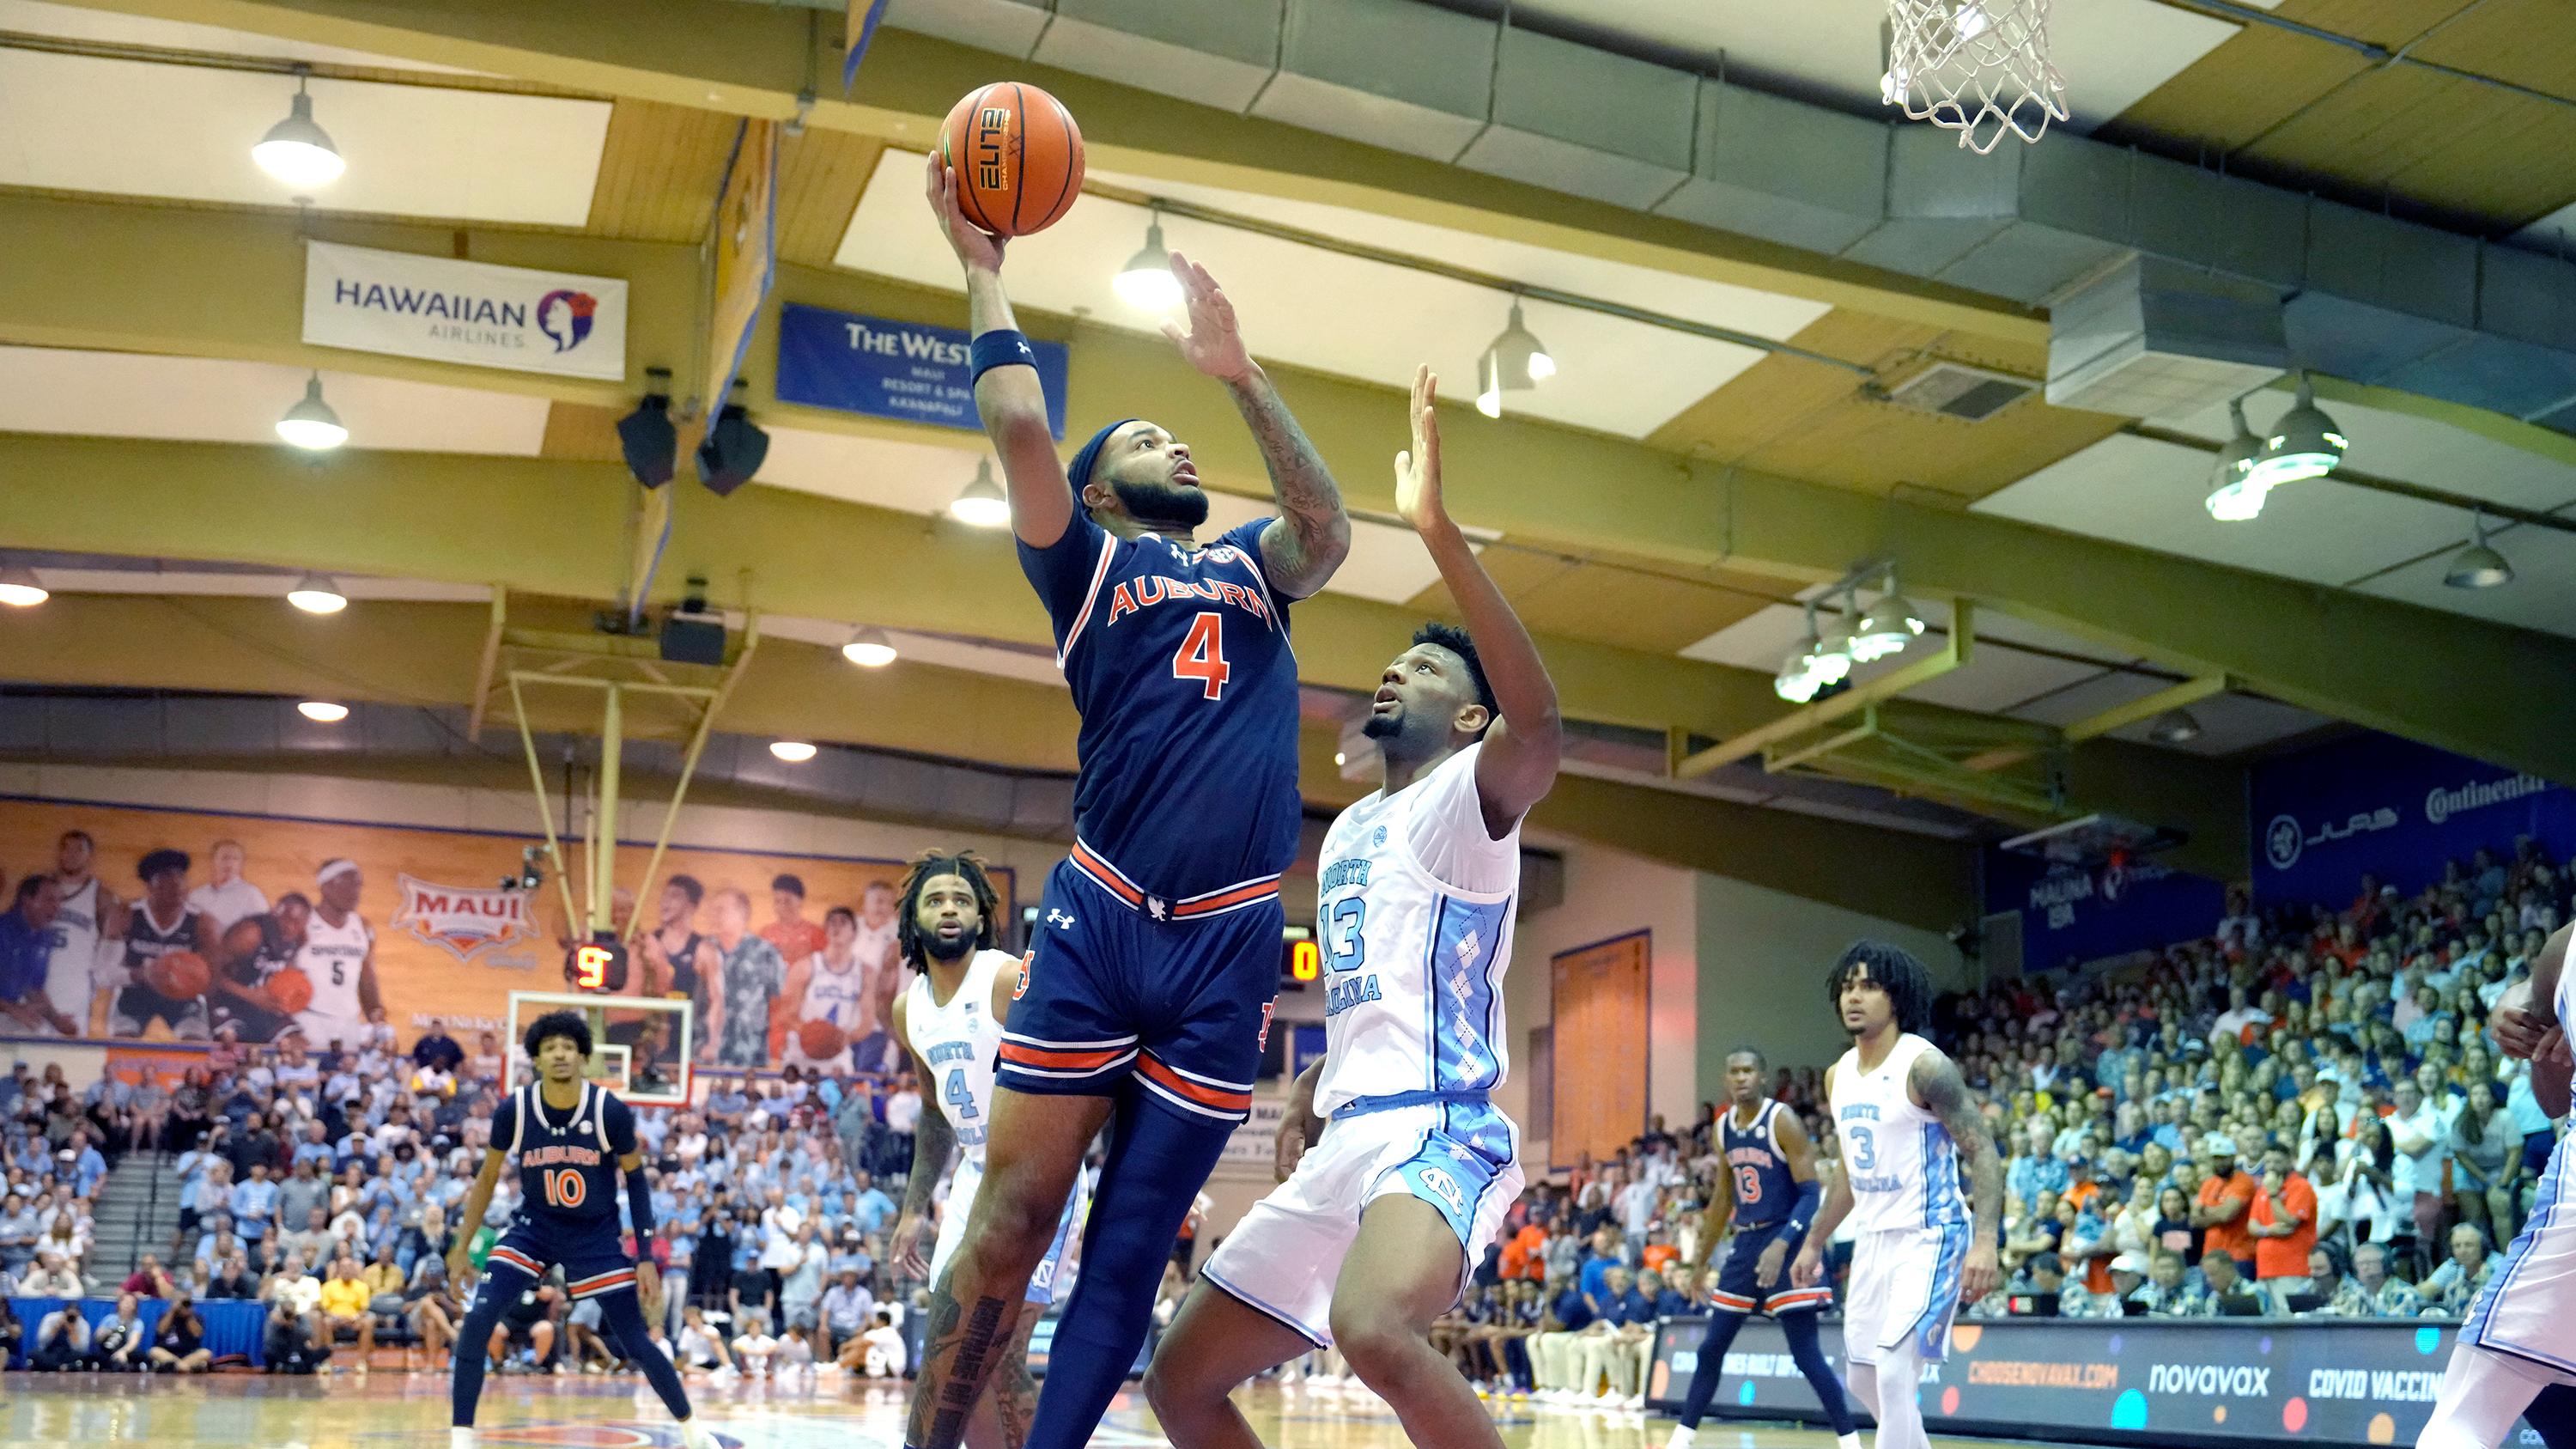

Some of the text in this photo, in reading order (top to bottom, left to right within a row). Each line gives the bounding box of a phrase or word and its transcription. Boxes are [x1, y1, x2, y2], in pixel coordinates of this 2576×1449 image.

[980, 107, 1004, 190] ELITE
[336, 278, 526, 329] HAWAIIAN
[428, 324, 525, 350] AIRLINES
[845, 321, 972, 367] THE WEST
[881, 377, 932, 395] RESORT
[945, 387, 972, 400] SPA
[1107, 574, 1273, 633] AUBURN
[1172, 611, 1230, 701] 4
[2425, 775, 2546, 825] Continental
[1320, 858, 1373, 898] NORTH
[415, 892, 519, 920] MAUI
[1319, 896, 1367, 977] 13
[332, 960, 345, 986] 5
[1293, 941, 1318, 982] 0
[927, 1040, 975, 1067] NORTH
[945, 1068, 980, 1119] 4
[522, 1145, 601, 1169] AUBURN
[1850, 1125, 1875, 1170] 3
[543, 1168, 587, 1209] 10
[1733, 1166, 1763, 1204] 13
[2148, 1363, 2271, 1397] novavax
[2308, 1368, 2445, 1403] COVID VACCIN
